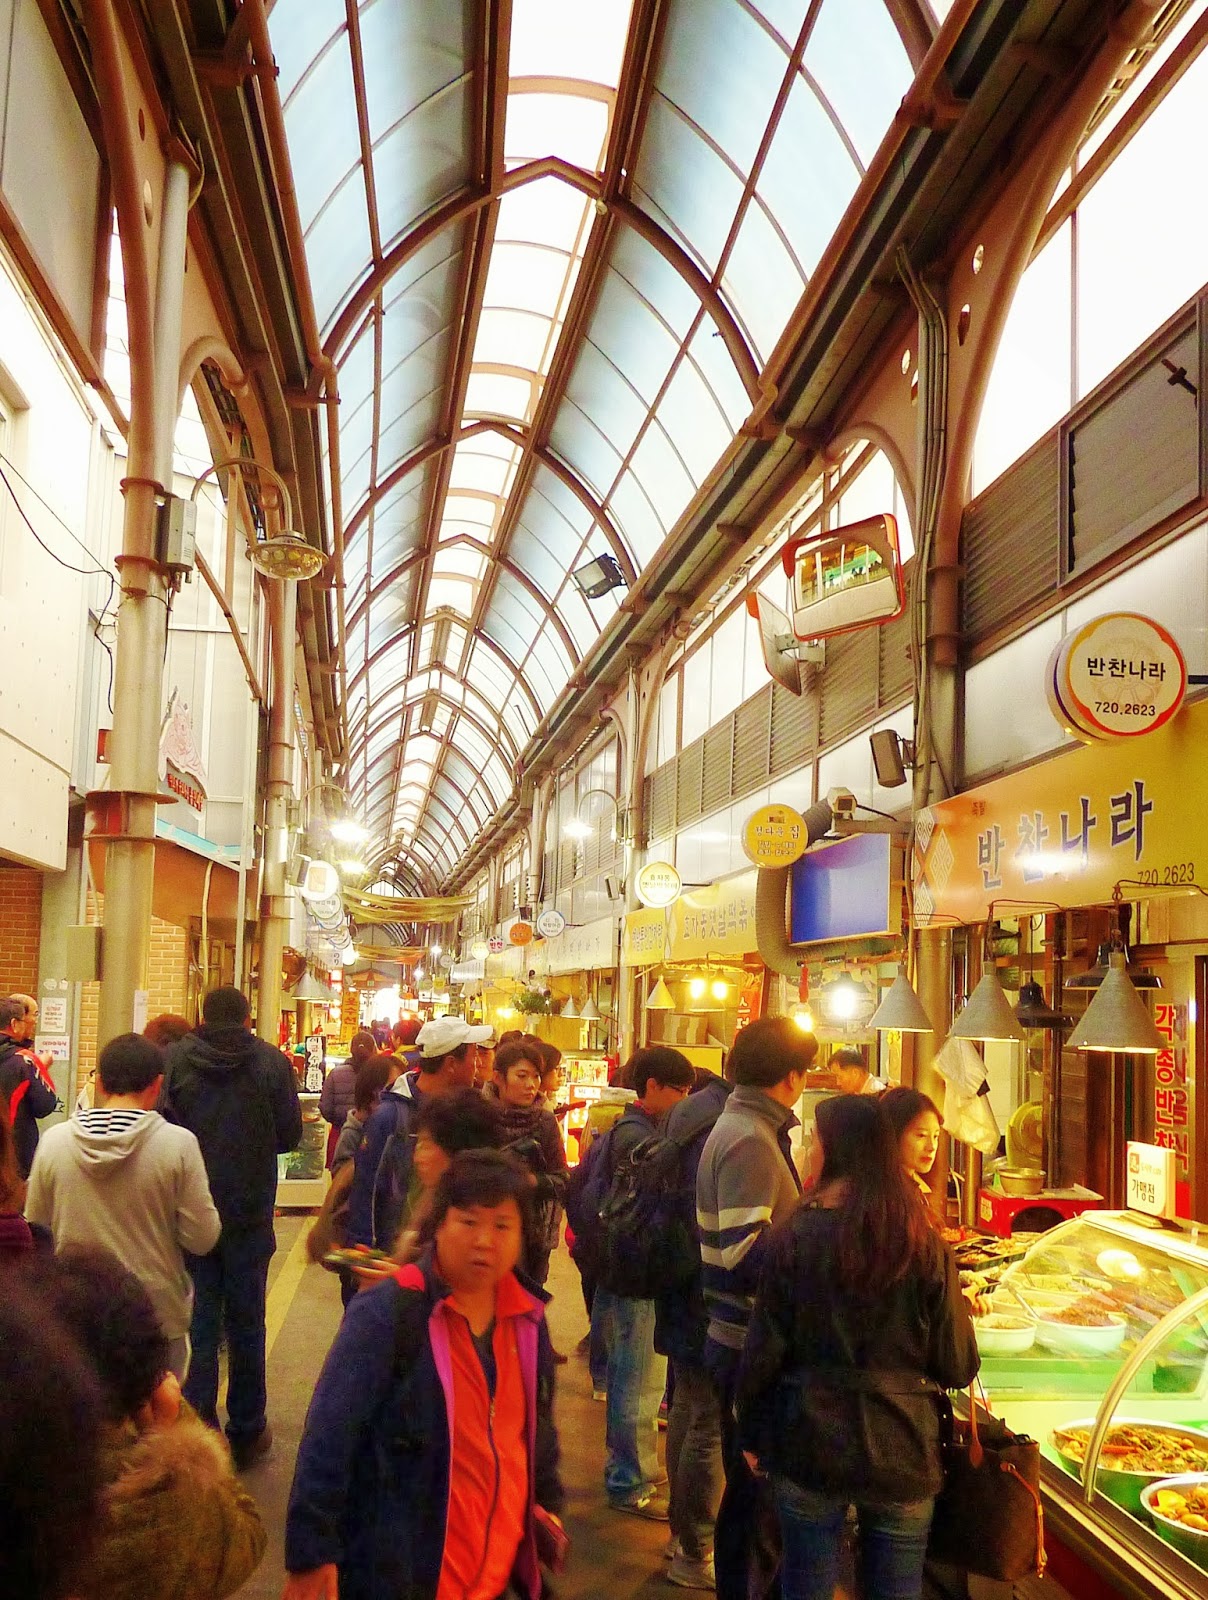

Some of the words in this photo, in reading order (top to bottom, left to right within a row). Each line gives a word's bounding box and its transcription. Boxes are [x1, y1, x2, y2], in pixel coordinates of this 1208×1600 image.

[1087, 656, 1166, 682] 반찬나라
[1095, 701, 1156, 717] 720.2623
[790, 825, 800, 839] 집
[977, 779, 1153, 891] 반찬나라
[1137, 863, 1195, 887] 720.2623
[1155, 1003, 1175, 1150] 각종반찬
[1132, 1179, 1155, 1204] 가맹점
